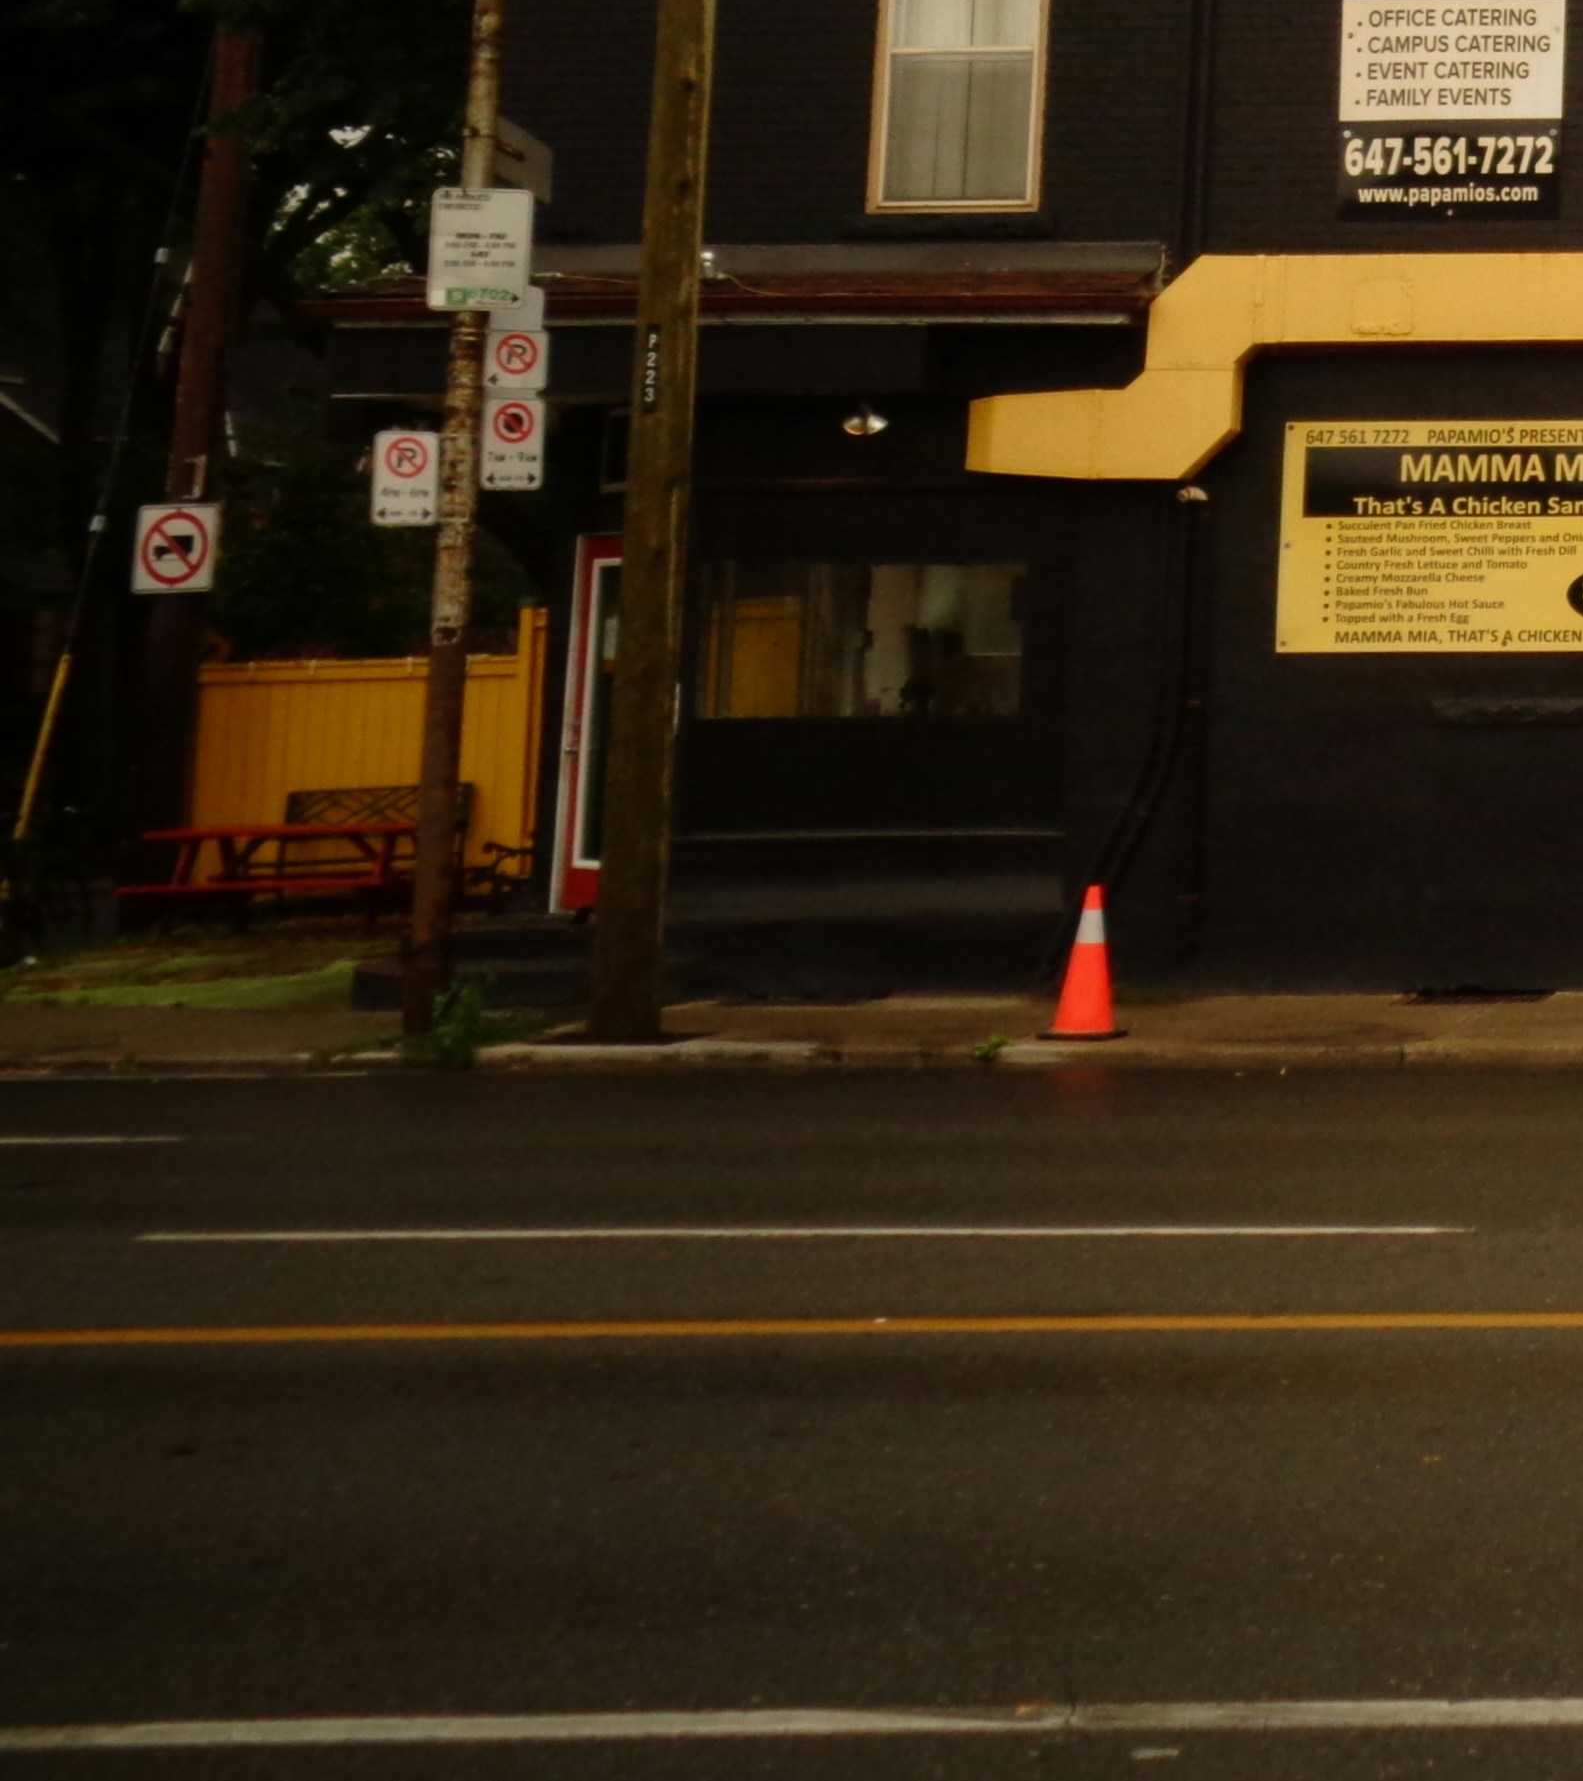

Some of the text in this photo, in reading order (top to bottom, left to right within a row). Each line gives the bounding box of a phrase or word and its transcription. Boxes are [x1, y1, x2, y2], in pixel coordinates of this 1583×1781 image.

[1369, 9, 1537, 28] OFFICE CATERING
[1368, 35, 1551, 54] CAMPUS CATERING
[1367, 62, 1530, 80] EVENT CATERING
[1366, 88, 1512, 107] FAMILY EVENTS
[1344, 136, 1554, 176] 647-561-7272
[1358, 183, 1539, 206] www.papamios.com
[1306, 429, 1334, 444] 647
[1339, 429, 1367, 444] 561
[1372, 429, 1410, 444] 7272
[1427, 427, 1515, 443] PAPAMIO'S
[1401, 453, 1545, 482] MAMMA
[1353, 496, 1423, 515] That's
[1429, 497, 1446, 514] A
[1452, 496, 1541, 515] Chicken
[1337, 520, 1532, 530] Succulent Pan Fried Chicken Breast
[1337, 534, 1382, 543] Sauteed
[1454, 533, 1488, 543] Sweet
[1491, 533, 1536, 546] Peppers
[1539, 533, 1560, 543] and
[1337, 546, 1577, 556] Fresh Garlic and Sweet Chilli with Fresh Dill
[1336, 559, 1528, 571] Country Fresh Lettuce and Tomato
[1336, 573, 1485, 585] Creamy Mozzarella Cheese
[1336, 586, 1428, 596] Baked Fresh Bun
[1335, 600, 1505, 611] Papamio's Fabulous Hot Sauce
[1335, 614, 1375, 625] Topped
[1378, 613, 1404, 623] with
[1417, 613, 1447, 623] Fresh
[1450, 613, 1470, 625] Egg
[1335, 631, 1403, 644] MAMMA
[1407, 631, 1443, 644] MIA,
[1448, 630, 1499, 643] THAT'S
[1502, 630, 1514, 643] A
[1518, 630, 1583, 643] CHICKEN
